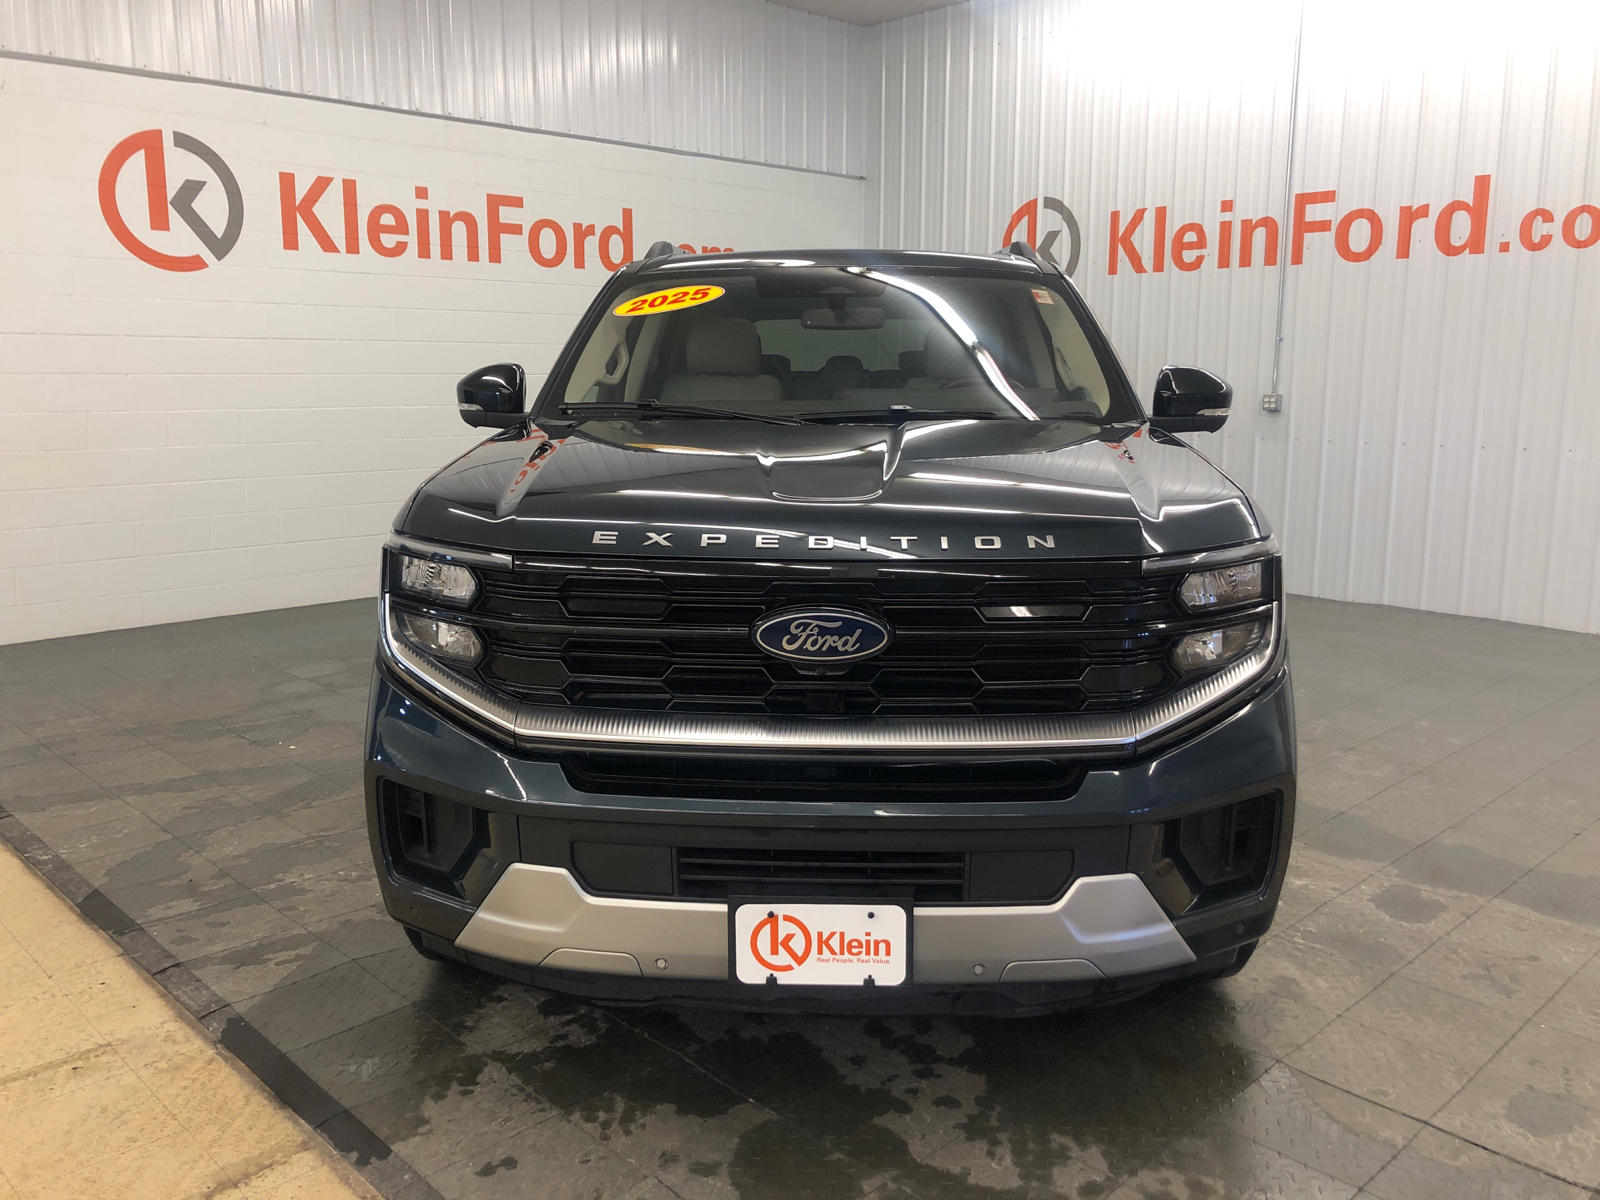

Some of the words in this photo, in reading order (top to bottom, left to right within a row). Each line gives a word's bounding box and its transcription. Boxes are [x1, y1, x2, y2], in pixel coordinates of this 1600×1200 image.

[625, 287, 712, 314] 2025
[591, 530, 1056, 550] EXPEDITION
[782, 619, 862, 652] Ford
[816, 931, 892, 957] Klein
